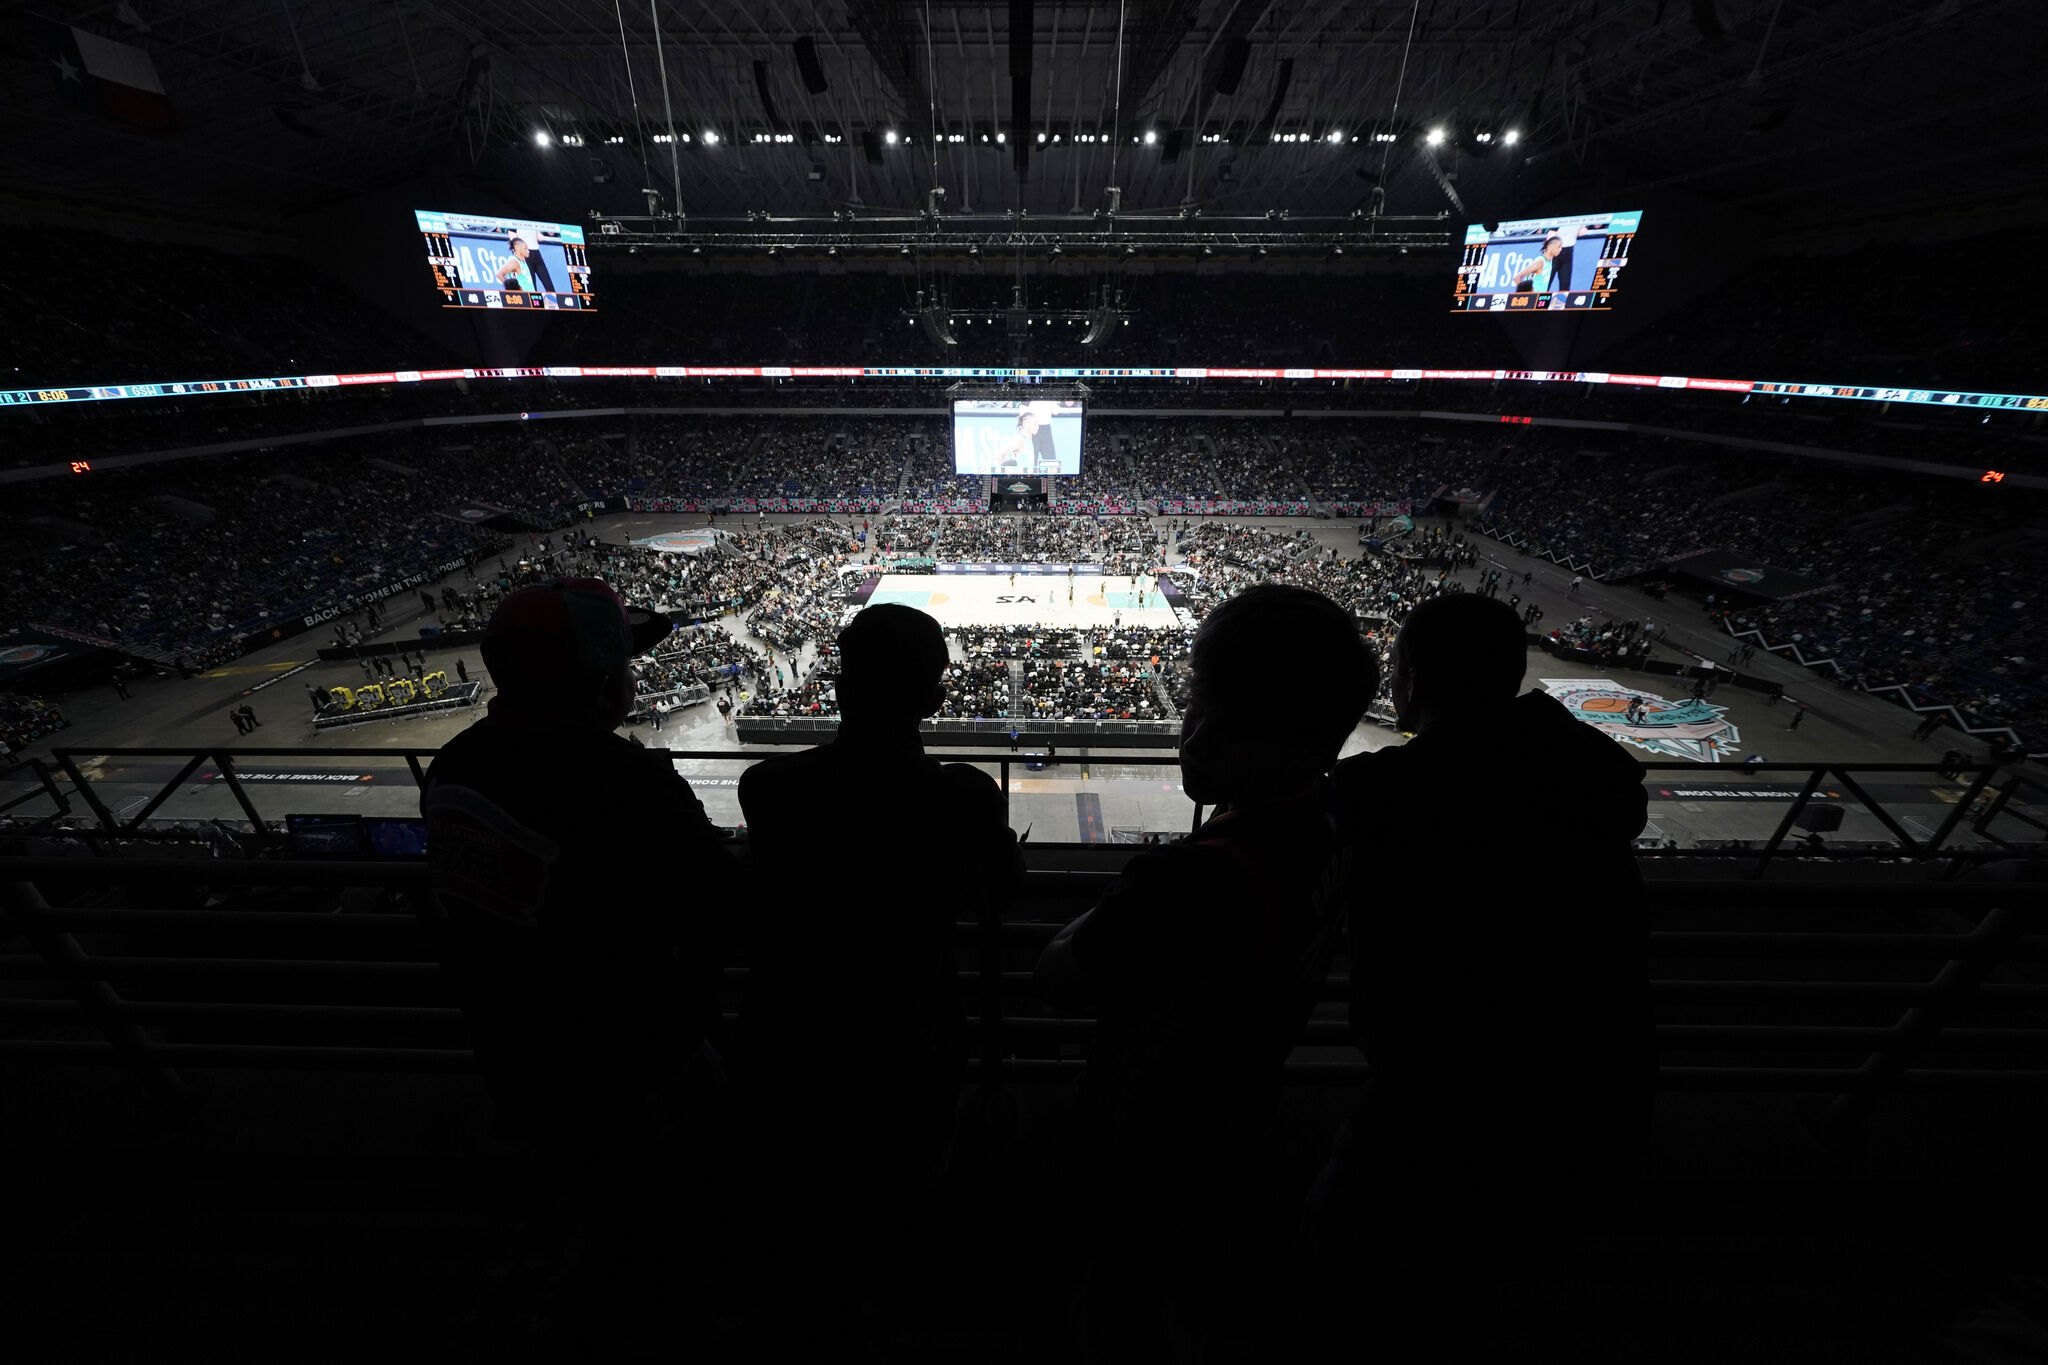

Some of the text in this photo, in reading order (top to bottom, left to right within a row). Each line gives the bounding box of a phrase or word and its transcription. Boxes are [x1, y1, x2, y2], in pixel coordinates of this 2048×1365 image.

[131, 385, 158, 397] GSW
[202, 382, 219, 392] FLS
[17, 391, 28, 403] 2
[38, 390, 69, 402] 8:06
[71, 461, 90, 473] 24
[1981, 470, 2005, 483] 24
[304, 606, 341, 627] BACK
[390, 581, 404, 594] IN
[995, 595, 1037, 604] SA
[1673, 789, 1713, 797] DOME
[1752, 790, 1790, 798] HOME
